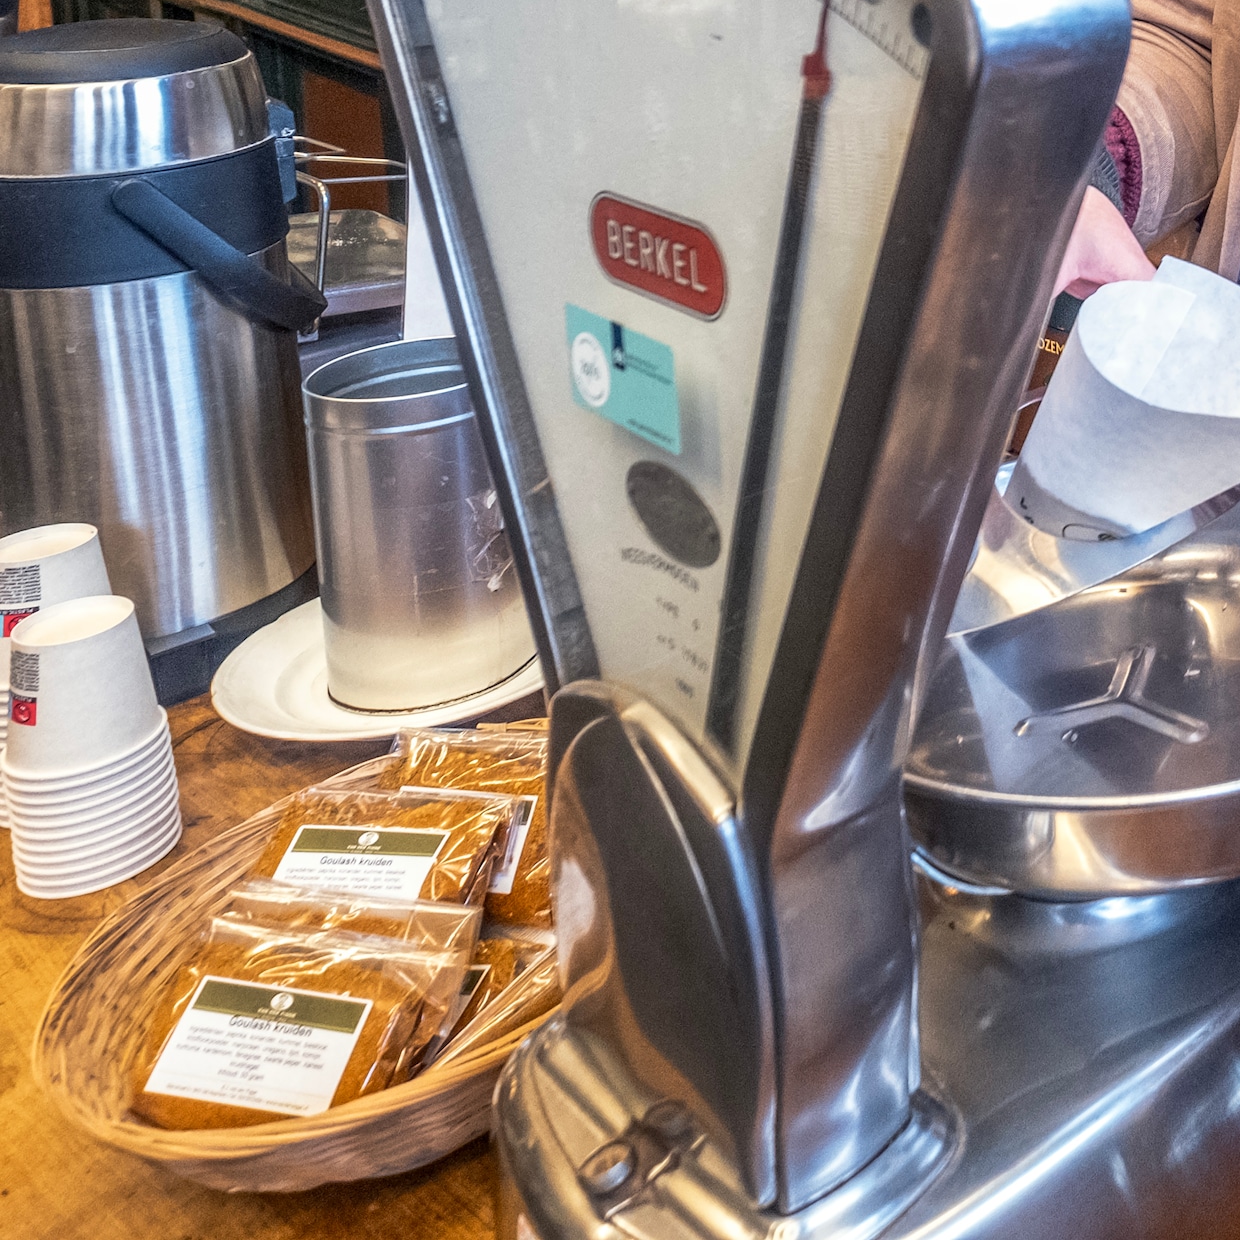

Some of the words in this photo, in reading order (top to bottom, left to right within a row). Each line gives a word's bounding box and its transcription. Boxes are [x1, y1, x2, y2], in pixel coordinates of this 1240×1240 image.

[606, 219, 709, 293] BERKEL
[319, 855, 357, 866] Goulash
[359, 857, 393, 867] kruiden
[229, 1014, 271, 1032] Goulash
[273, 1021, 313, 1038] kruiden
